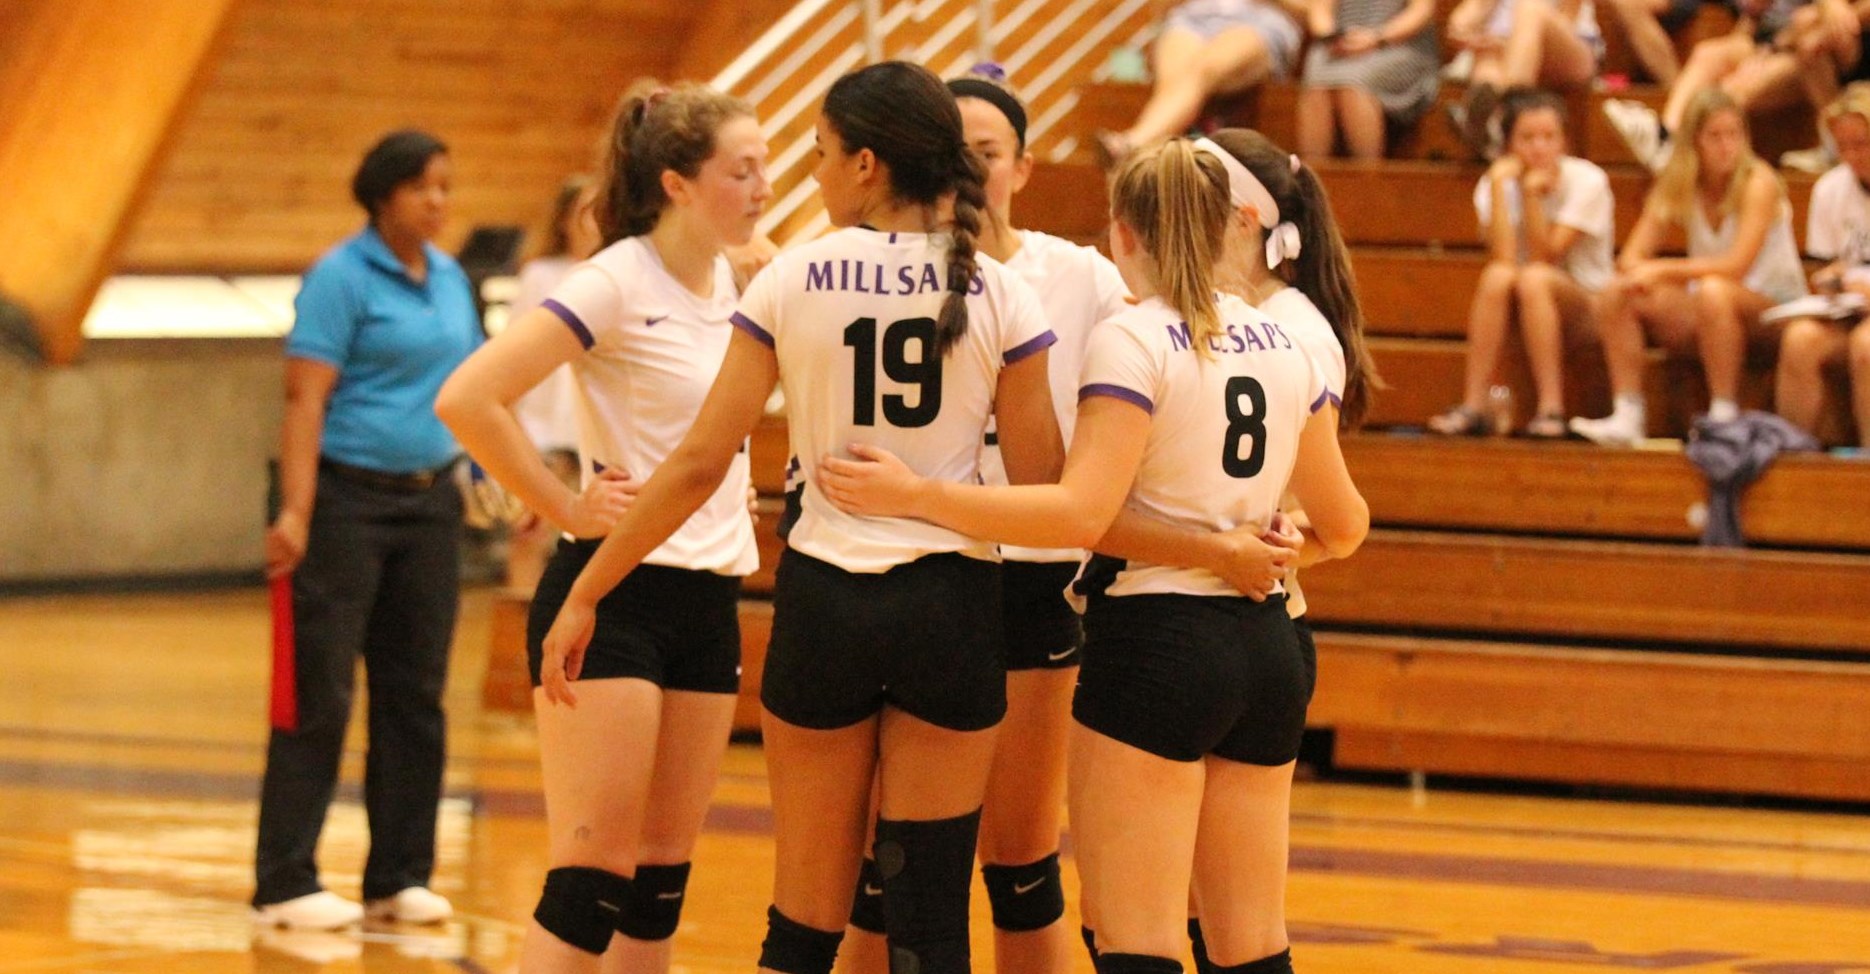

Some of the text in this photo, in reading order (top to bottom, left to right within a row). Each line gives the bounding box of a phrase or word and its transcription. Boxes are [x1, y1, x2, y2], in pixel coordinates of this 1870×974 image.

[805, 259, 984, 296] MILLSAS
[843, 317, 943, 428] 19
[1222, 375, 1267, 479] 8
